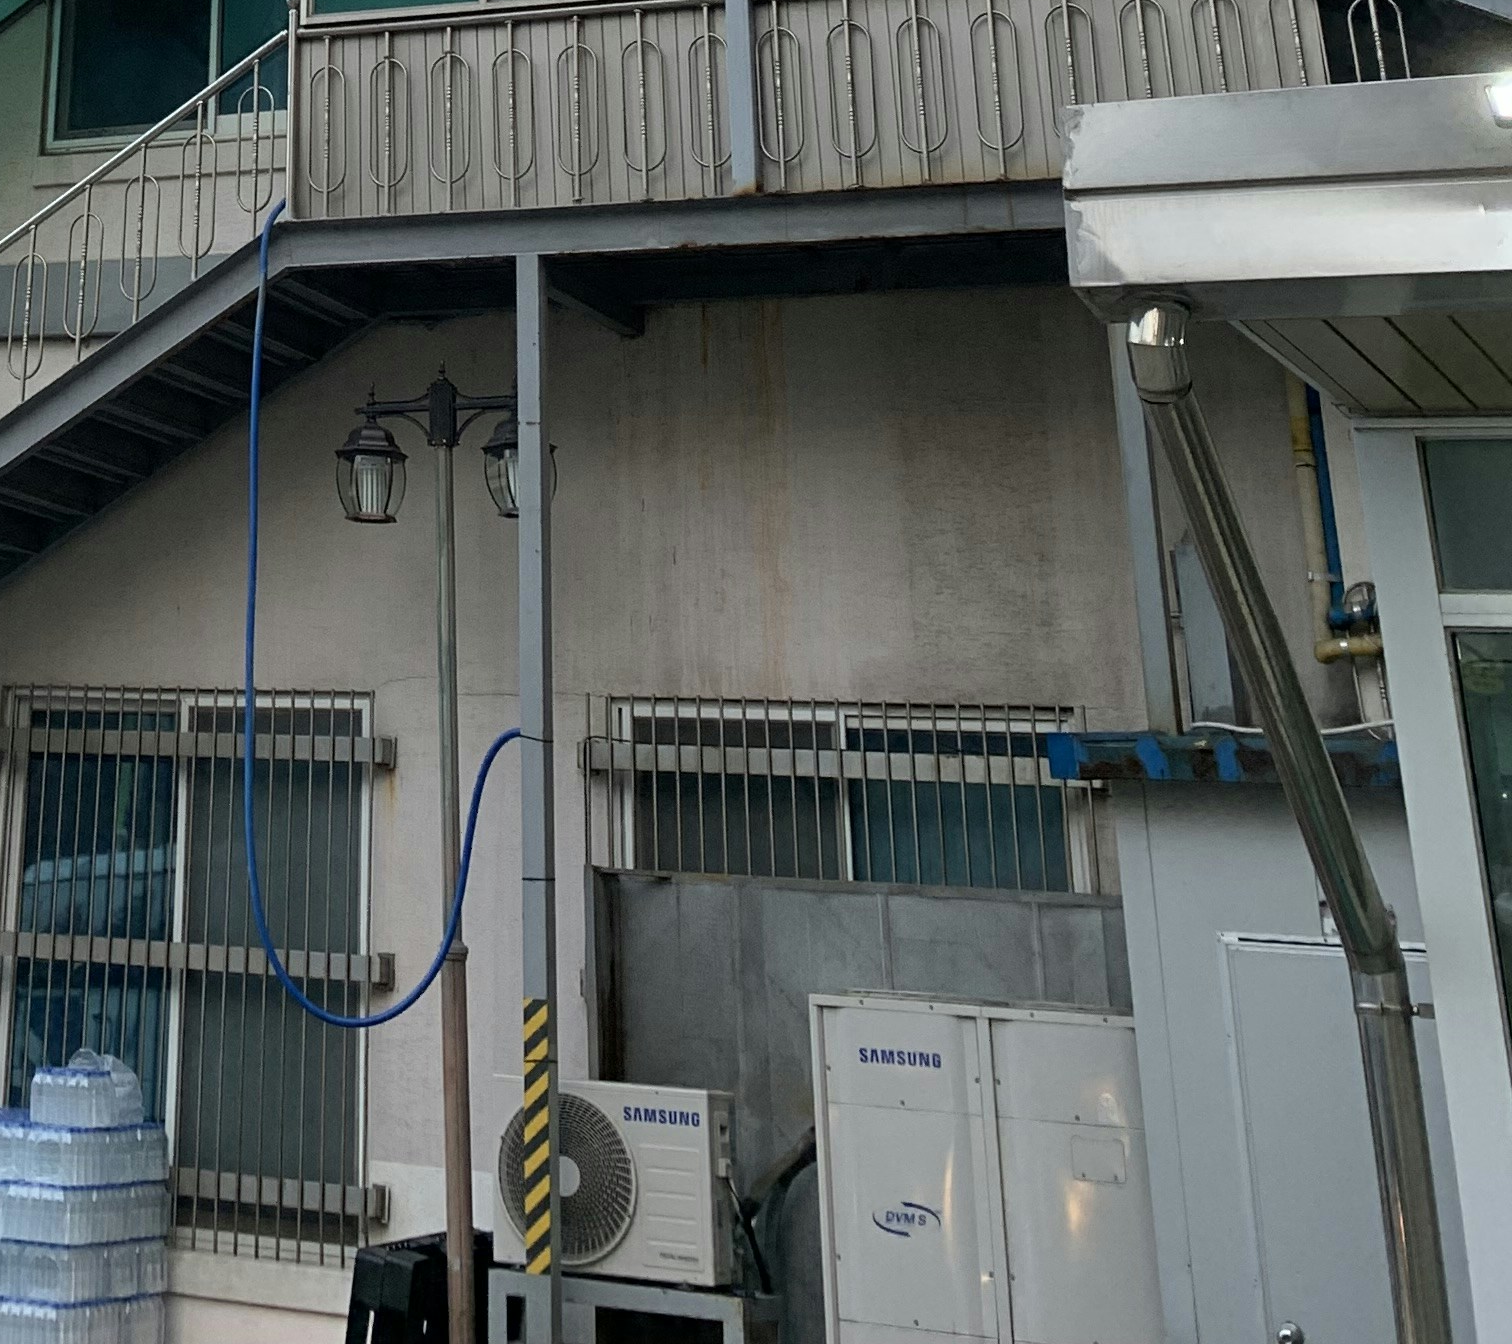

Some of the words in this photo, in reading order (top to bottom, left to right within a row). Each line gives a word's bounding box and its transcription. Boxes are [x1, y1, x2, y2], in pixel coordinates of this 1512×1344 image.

[858, 1047, 942, 1069] SAMSUNG
[623, 1106, 701, 1128] SAMSUNG
[885, 1210, 916, 1225] DVM
